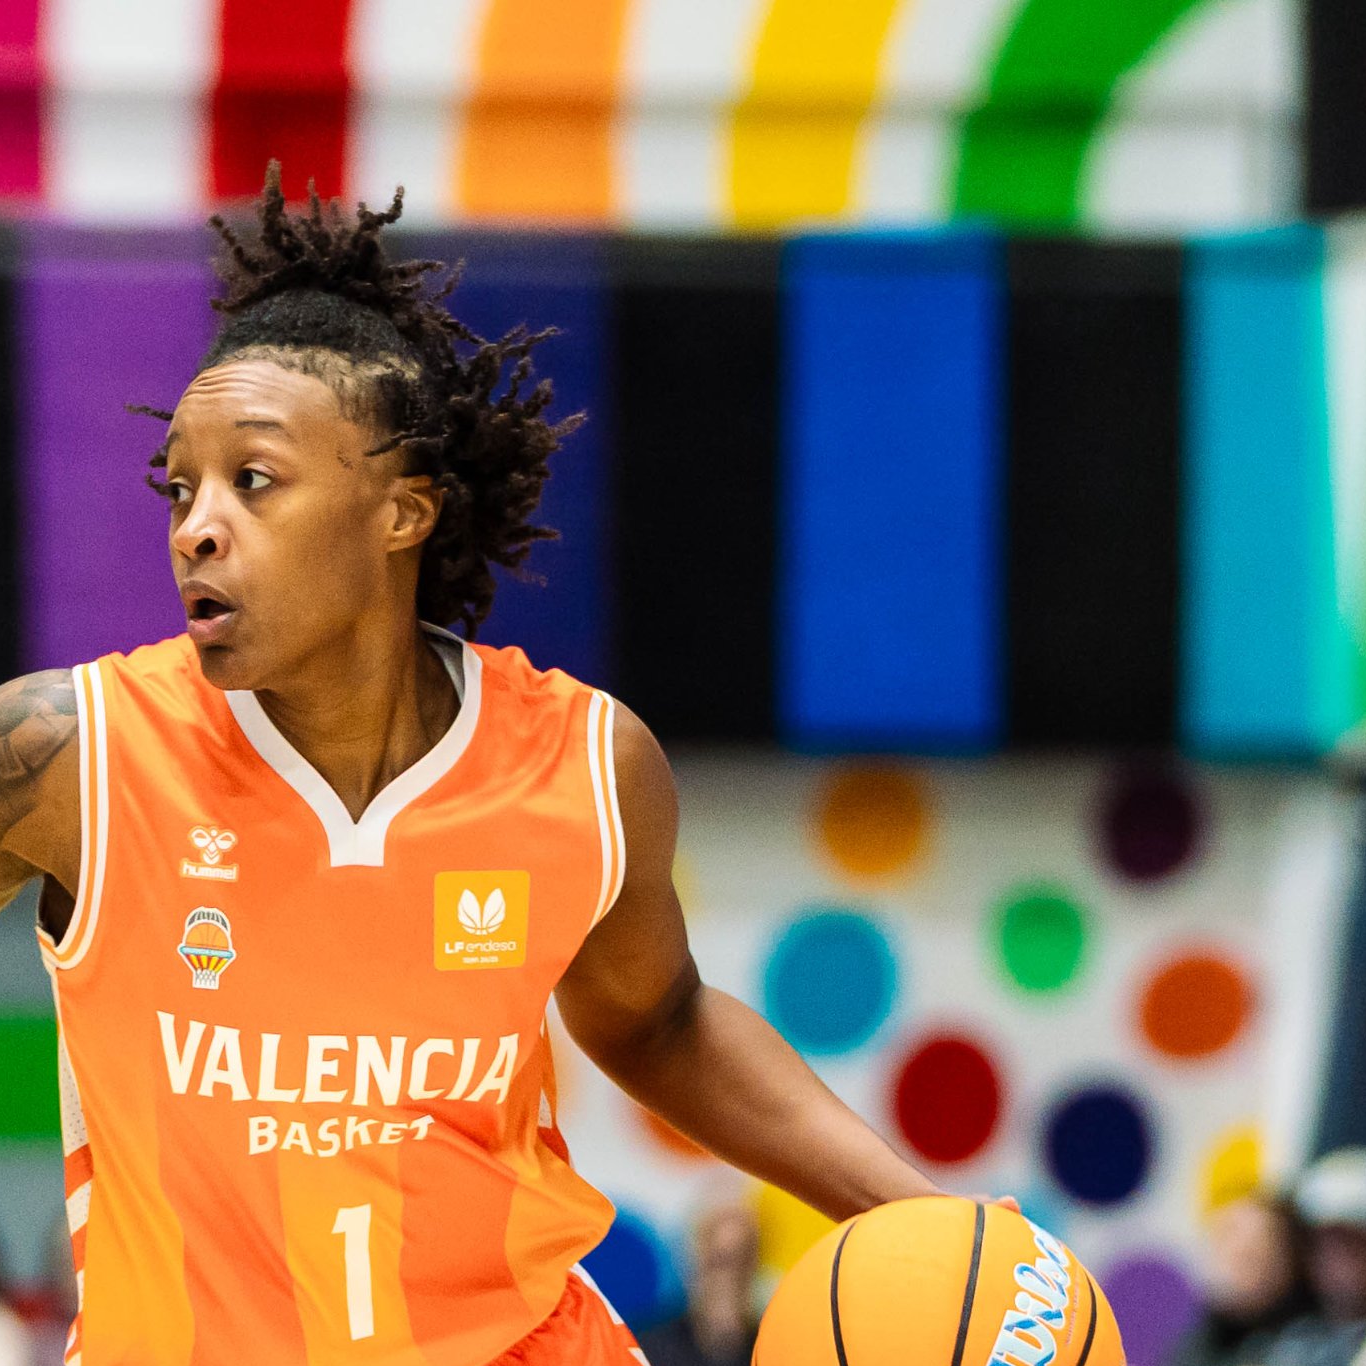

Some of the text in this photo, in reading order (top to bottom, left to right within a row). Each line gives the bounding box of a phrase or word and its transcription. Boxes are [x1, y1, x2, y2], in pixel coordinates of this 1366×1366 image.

[181, 860, 237, 880] hummel
[444, 939, 517, 954] LF endesa
[156, 1010, 520, 1106] VALENCIA
[248, 1114, 435, 1158] BASKET
[331, 1204, 375, 1341] 1
